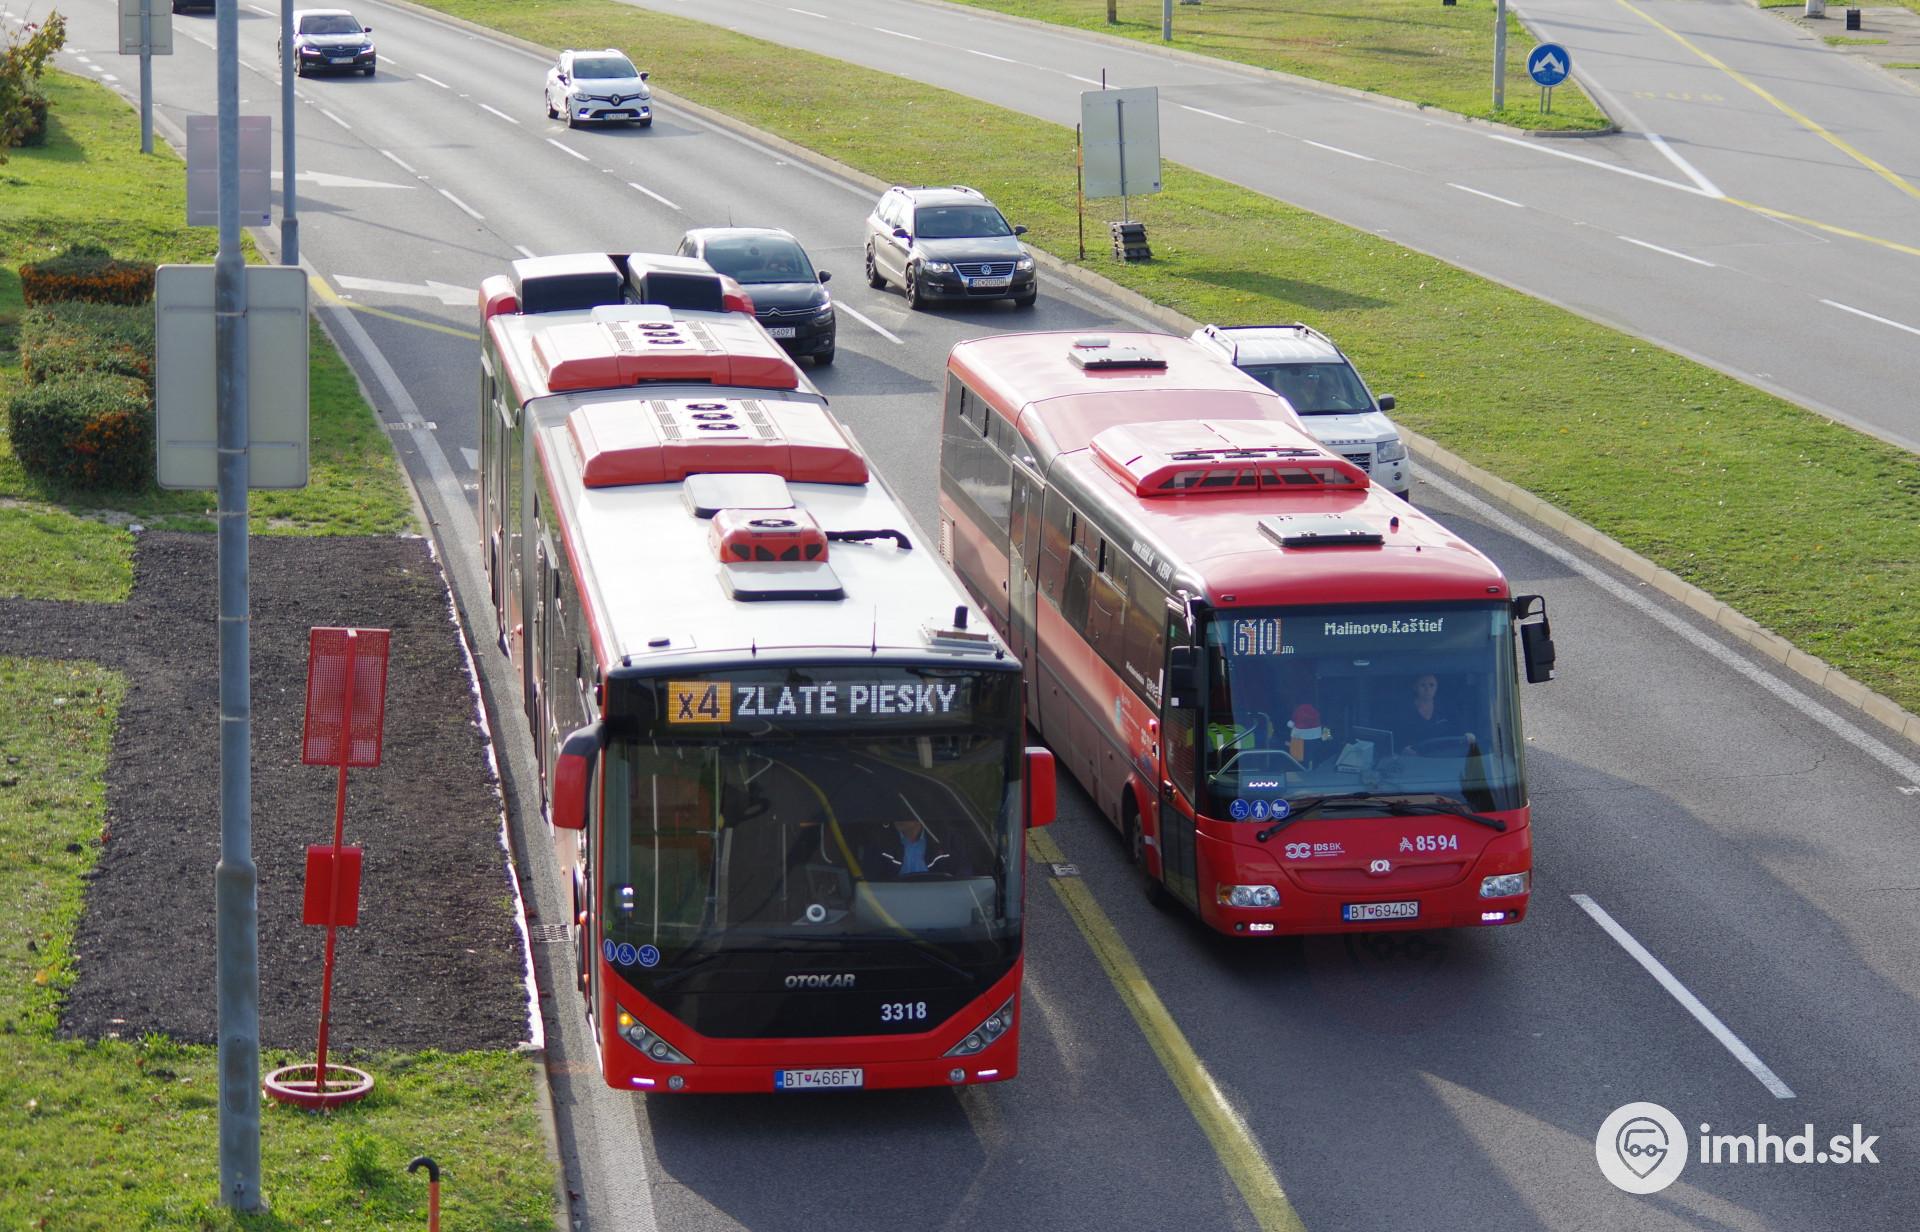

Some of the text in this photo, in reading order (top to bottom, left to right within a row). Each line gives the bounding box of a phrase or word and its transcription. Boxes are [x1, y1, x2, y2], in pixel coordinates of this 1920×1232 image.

[1233, 618, 1282, 656] 610
[737, 681, 837, 716] ZLATÉ
[850, 683, 957, 714] PIESKY
[1313, 842, 1342, 851] IDS BK
[1416, 834, 1458, 851] 8594
[785, 973, 856, 988] OTOKAR
[881, 1001, 927, 1021] 3318
